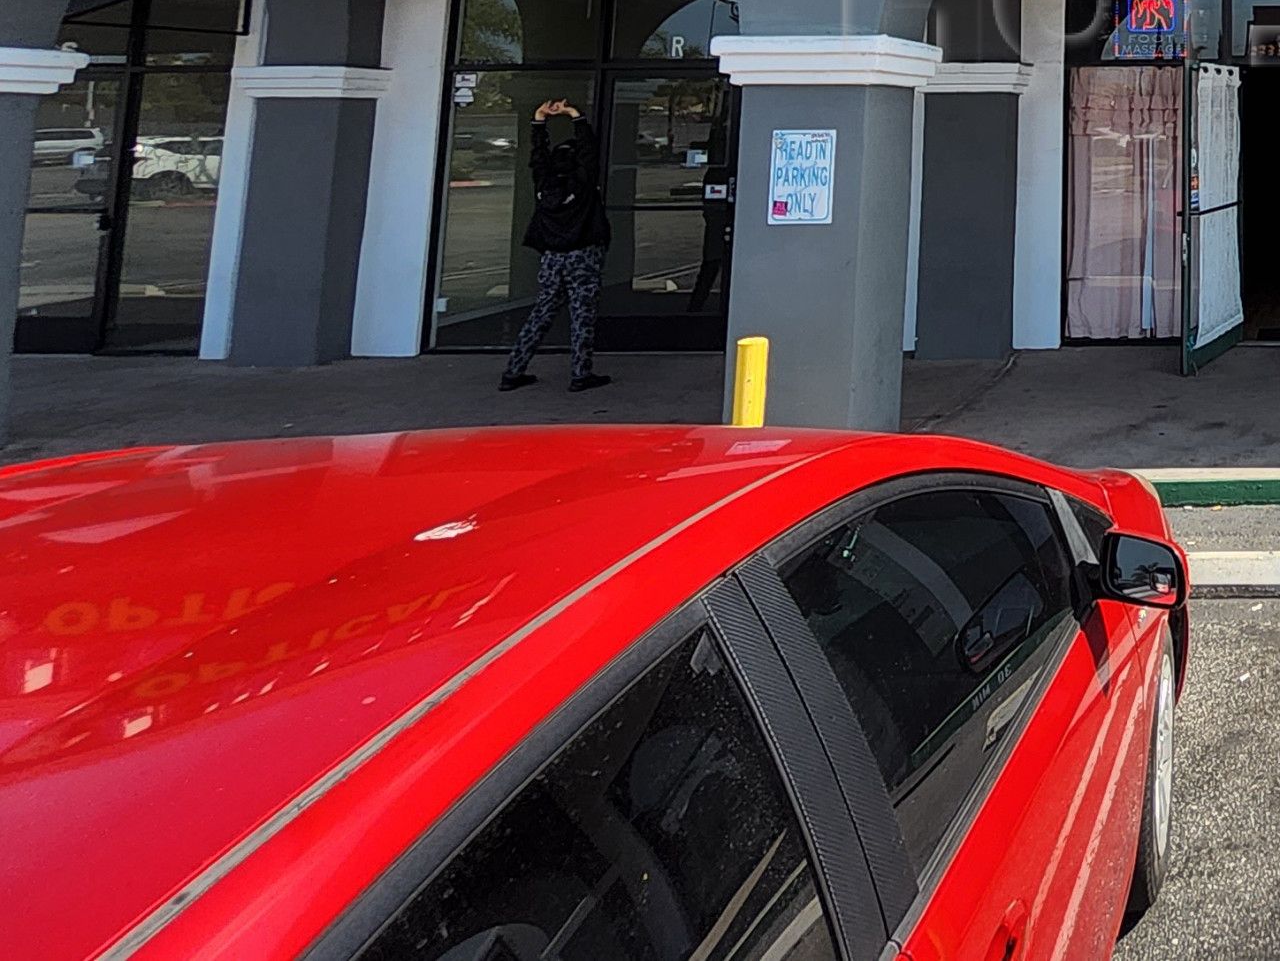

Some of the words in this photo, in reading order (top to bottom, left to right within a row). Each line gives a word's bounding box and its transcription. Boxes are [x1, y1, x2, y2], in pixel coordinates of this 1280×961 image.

[671, 36, 685, 57] R
[1128, 33, 1174, 44] FOOT
[1121, 44, 1181, 55] MASSAGE
[780, 140, 812, 160] HEAD
[815, 141, 827, 160] IN
[776, 166, 828, 187] PARKING
[786, 193, 816, 214] ONLY
